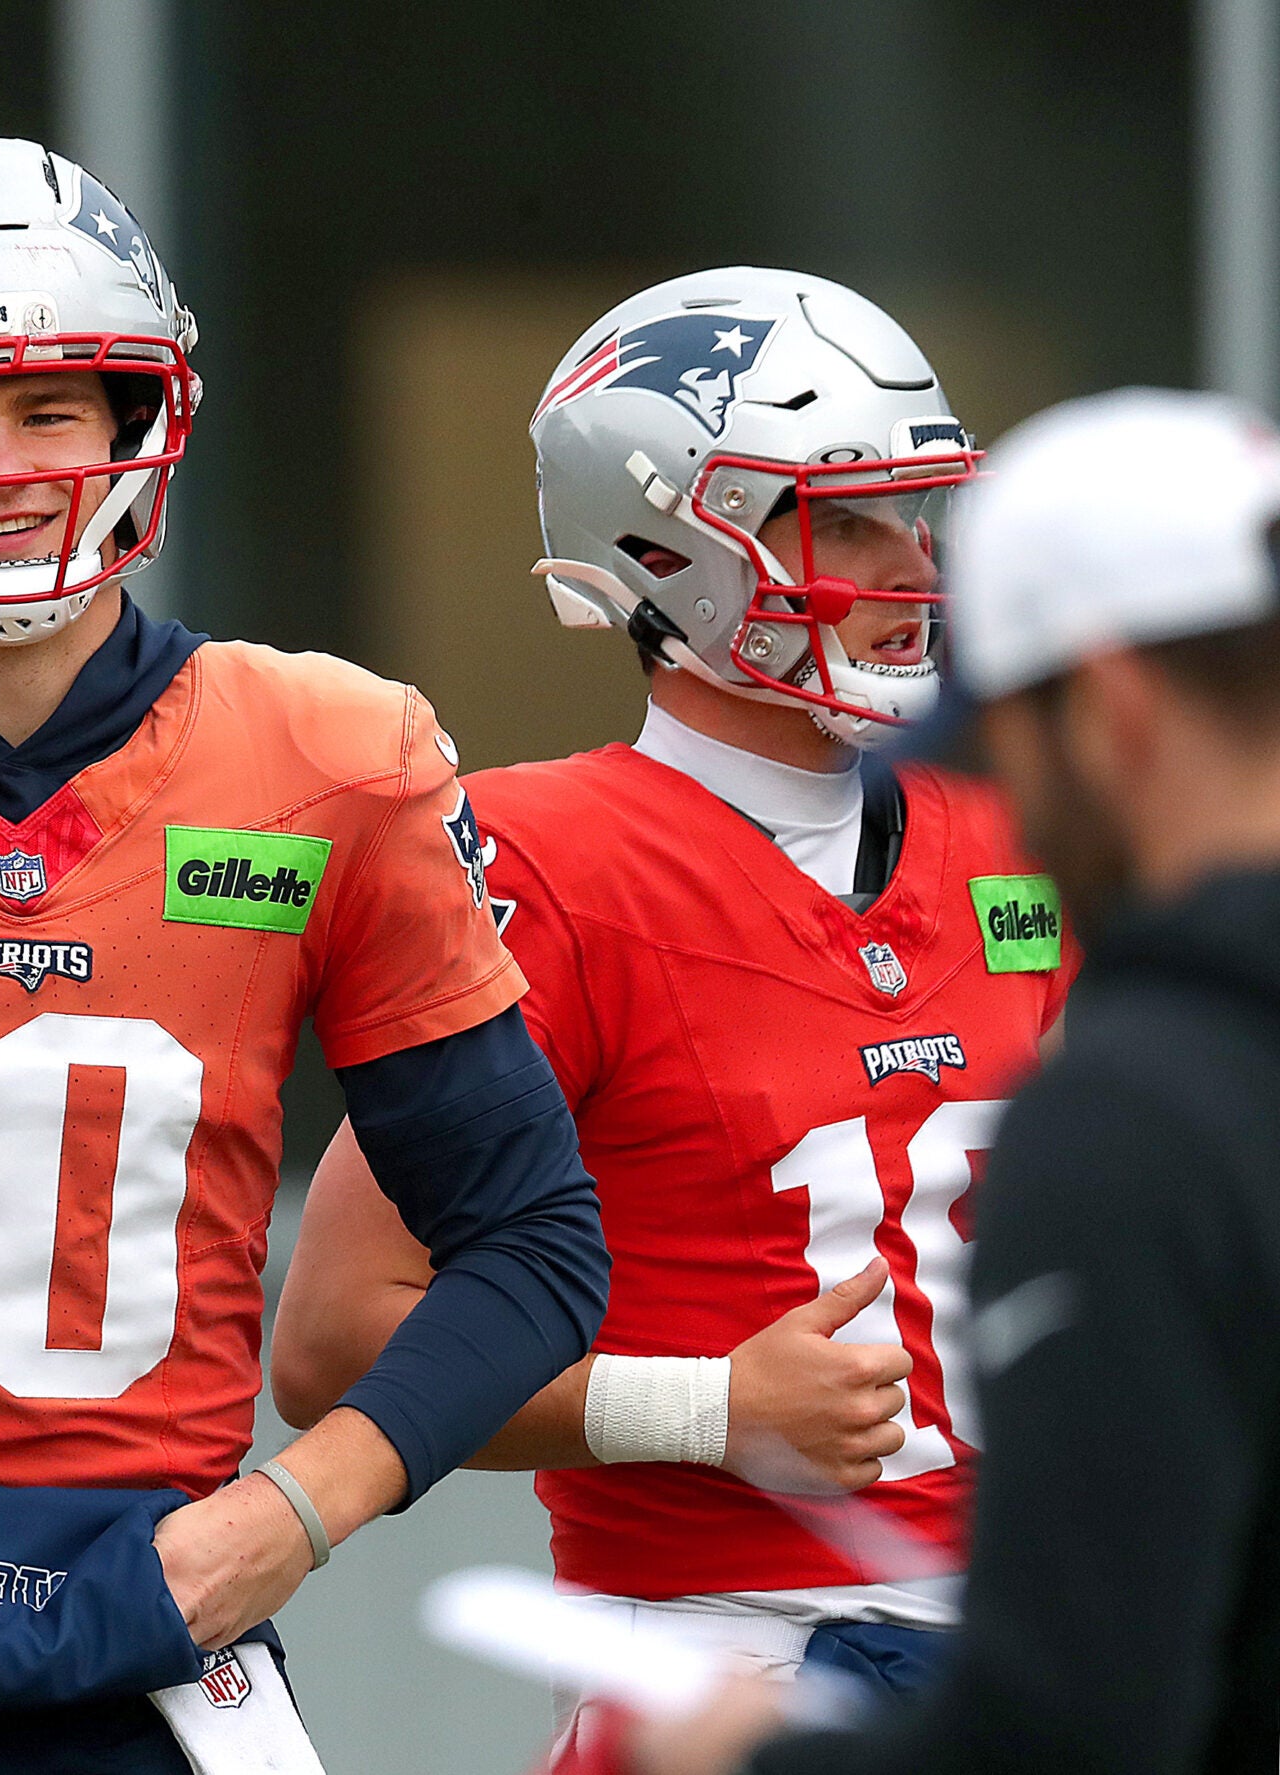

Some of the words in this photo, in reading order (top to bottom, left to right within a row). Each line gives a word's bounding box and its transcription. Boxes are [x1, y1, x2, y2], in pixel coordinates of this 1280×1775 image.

[3, 871, 39, 892] NFL
[177, 857, 312, 908] Gillette
[988, 900, 1058, 942] Gillette
[874, 963, 902, 984] NFL
[863, 1036, 965, 1080] PATRIOTS
[200, 1663, 247, 1703] NFL
